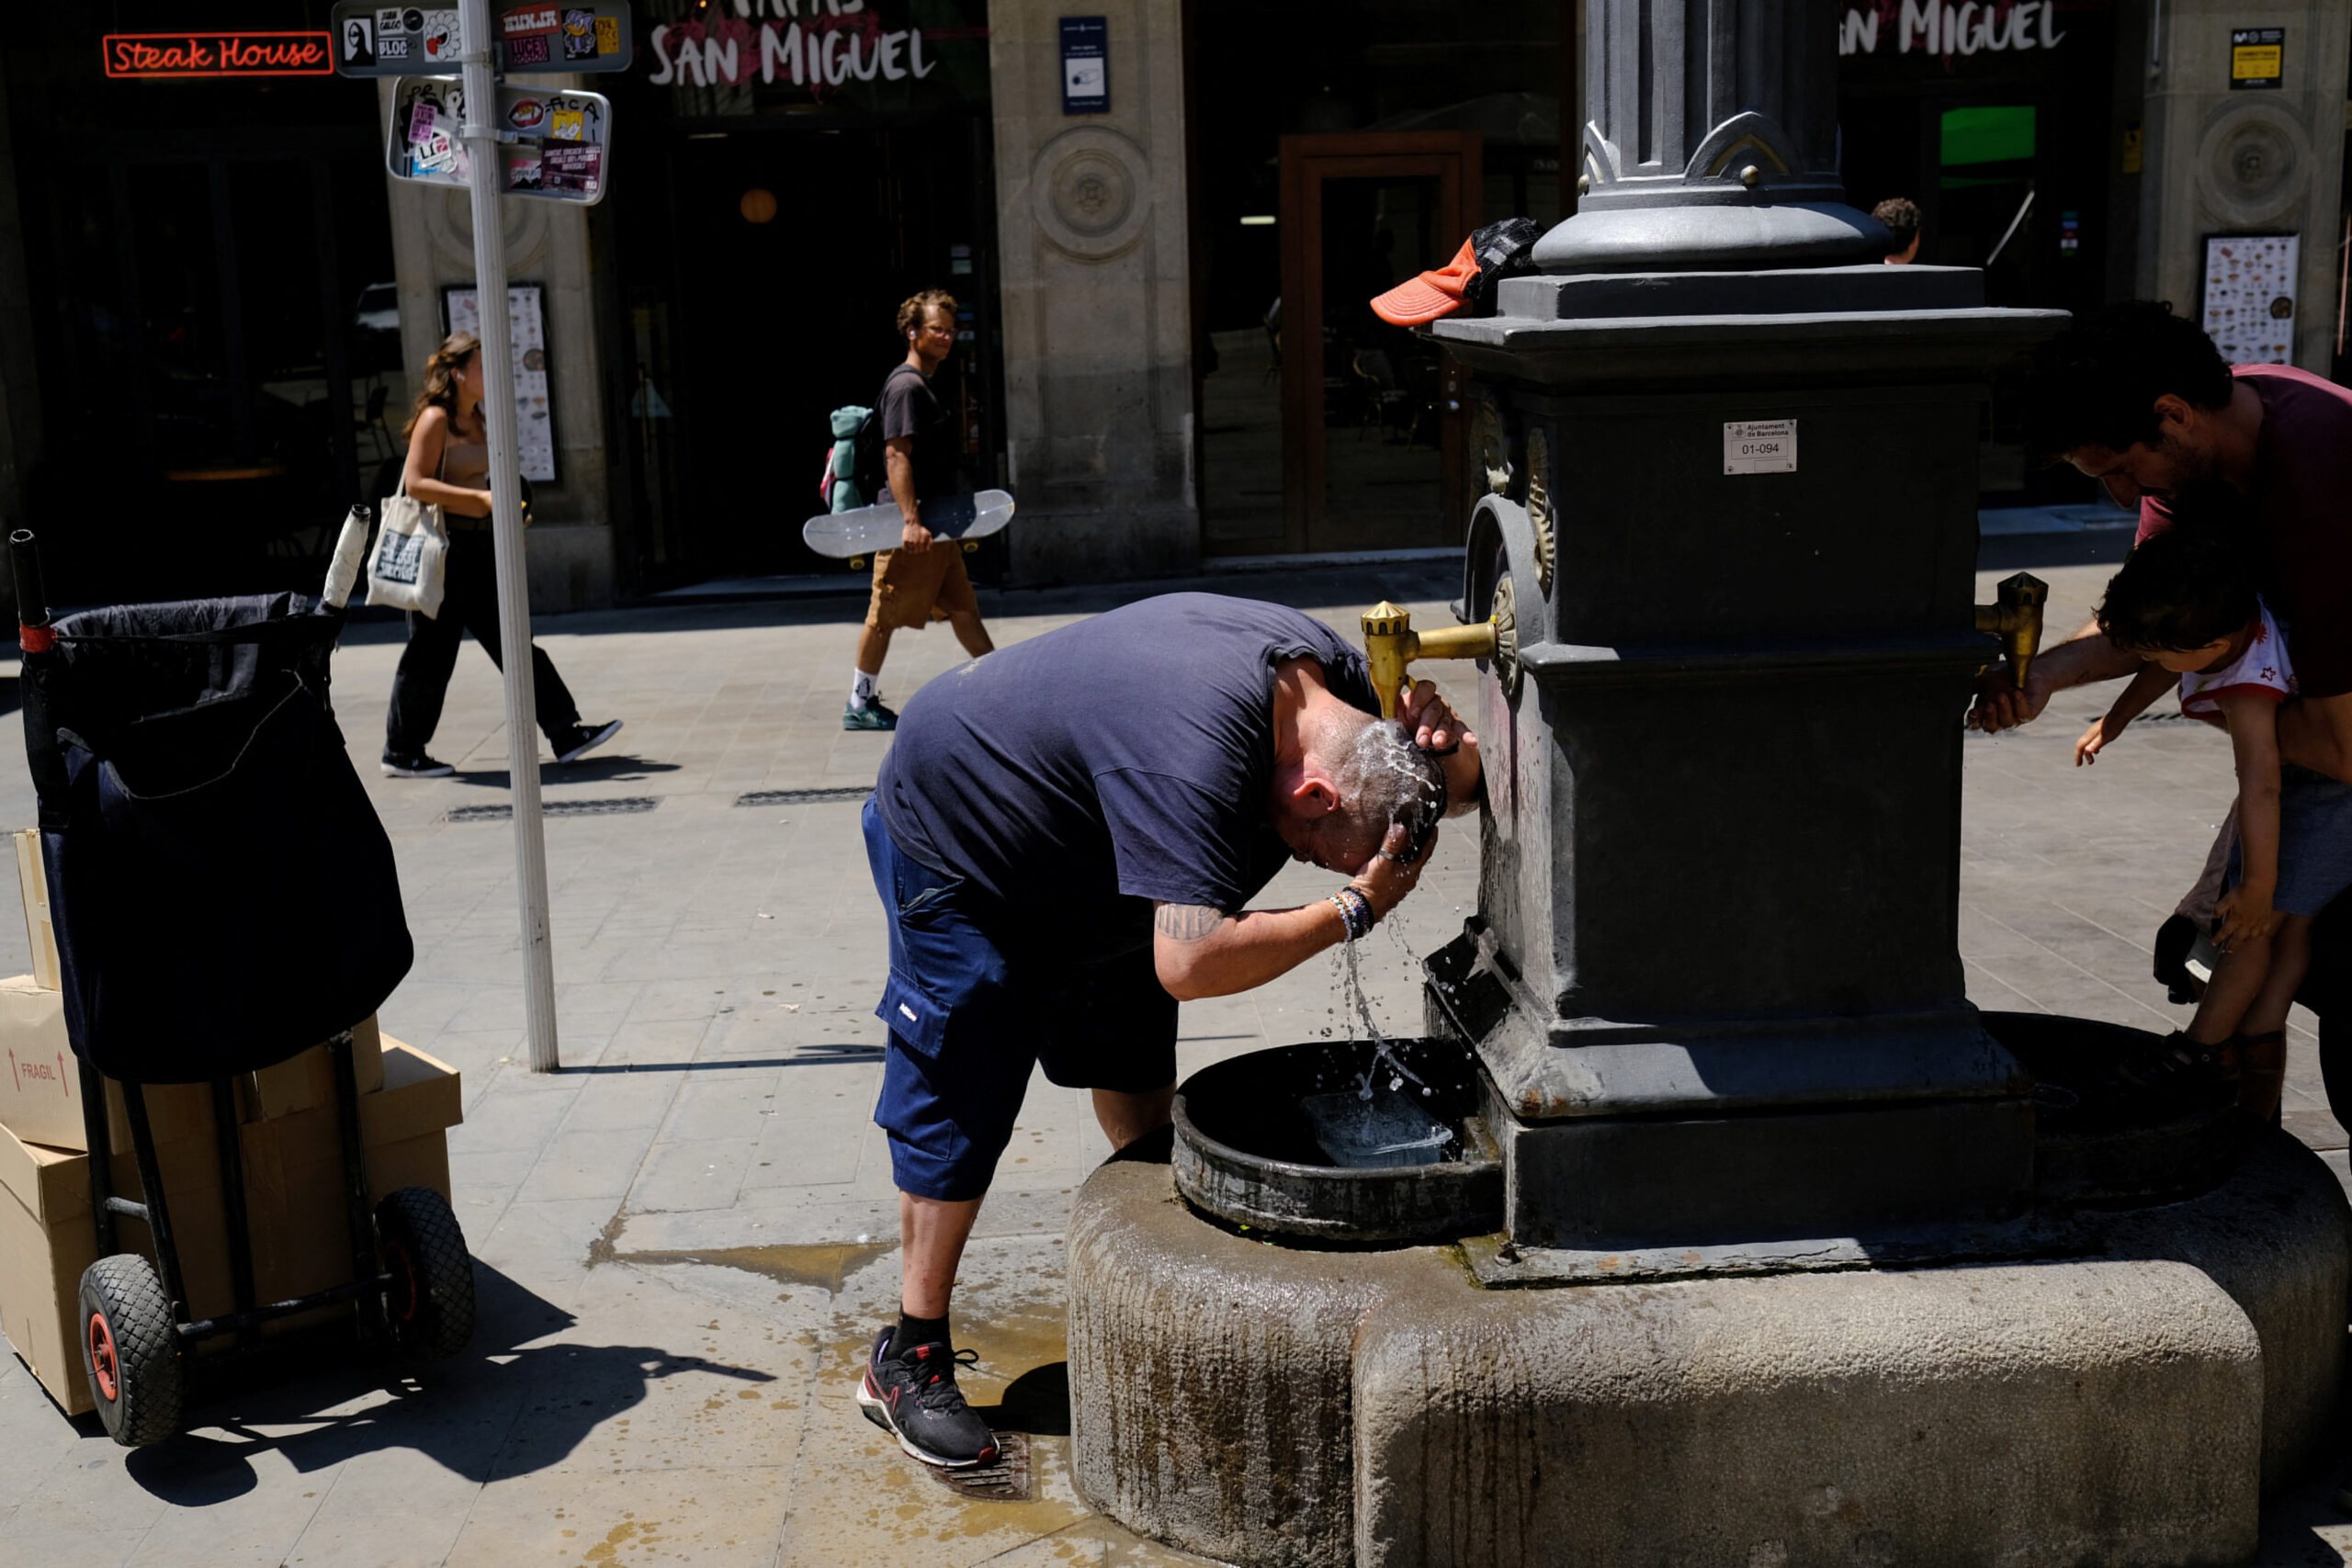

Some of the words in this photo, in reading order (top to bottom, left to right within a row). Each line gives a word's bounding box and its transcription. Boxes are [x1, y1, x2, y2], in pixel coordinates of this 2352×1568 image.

[1899, 0, 2066, 55] MIGUEL
[114, 39, 213, 71] Steak
[218, 38, 324, 69] House
[379, 40, 408, 55] BLOC
[649, 24, 738, 87] SAN
[760, 22, 937, 85] MIGUEL
[1747, 423, 1785, 432] Ajuntament
[1742, 443, 1779, 454] 01-094
[21, 1063, 56, 1080] FRAGIL
